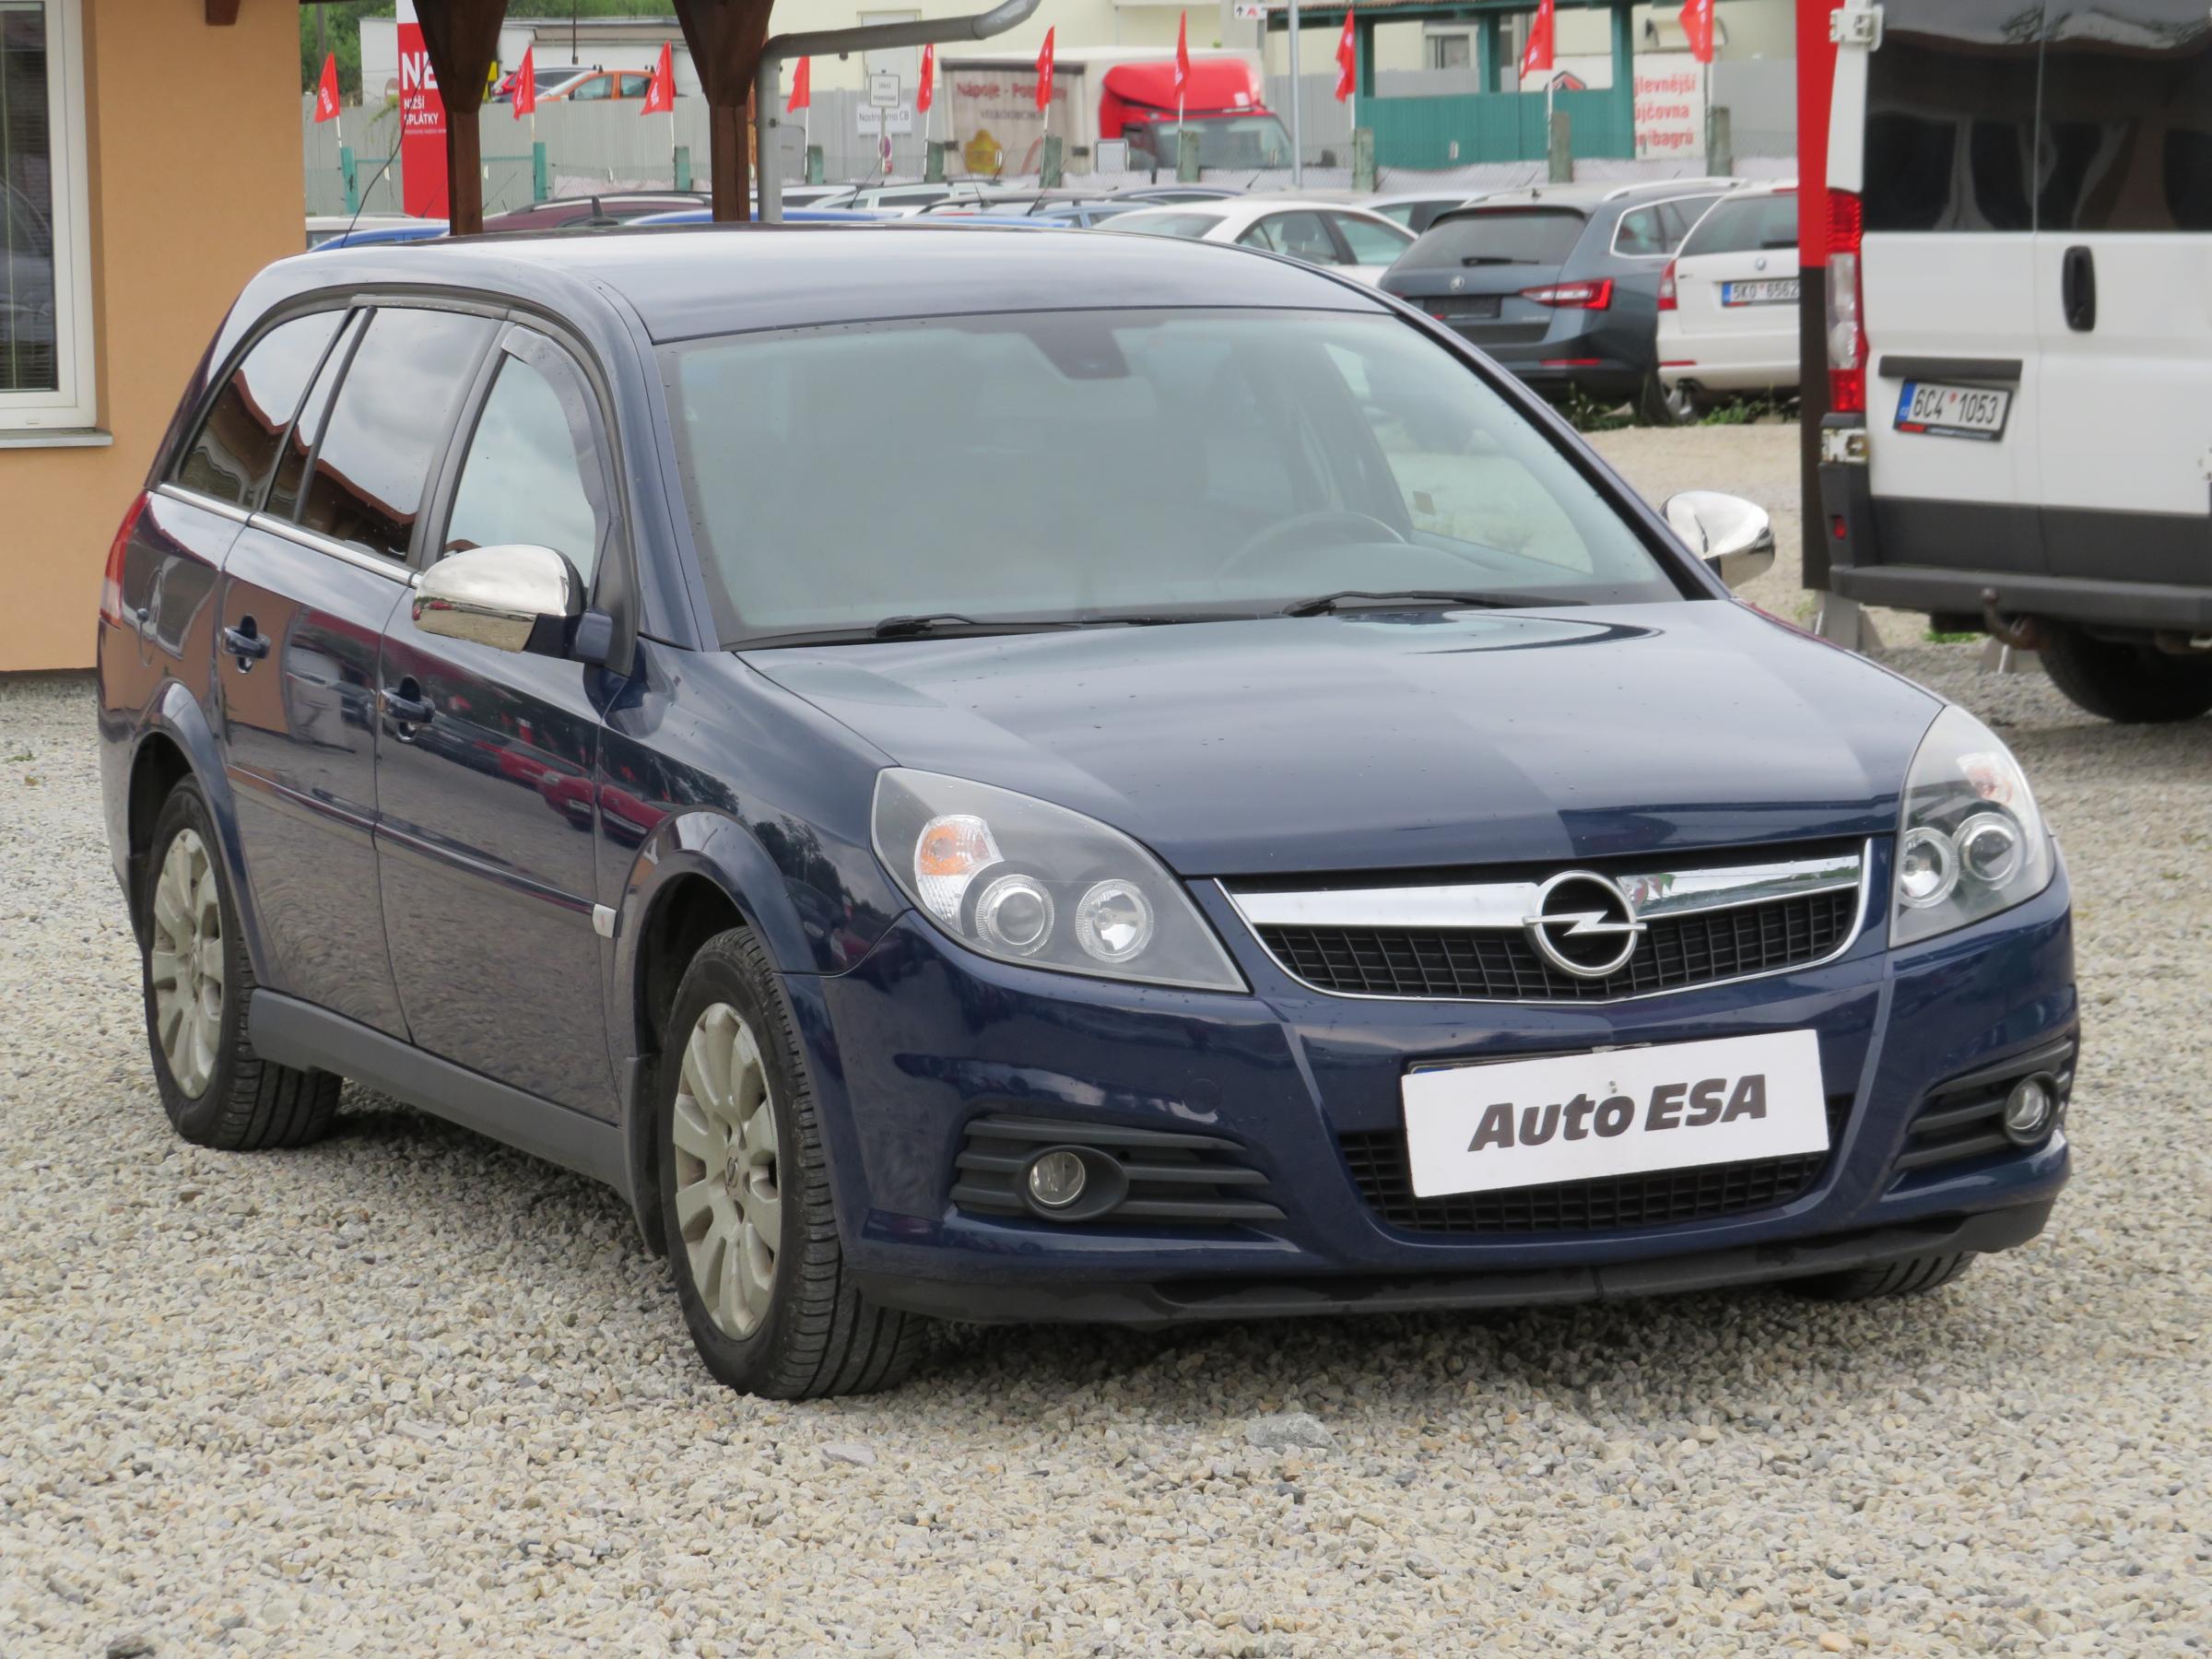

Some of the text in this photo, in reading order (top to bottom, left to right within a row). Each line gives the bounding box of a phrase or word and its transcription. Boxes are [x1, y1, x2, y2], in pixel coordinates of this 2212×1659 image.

[1912, 388, 1998, 425] 6C4 1053
[1467, 1074, 1768, 1152] Auto ESA
